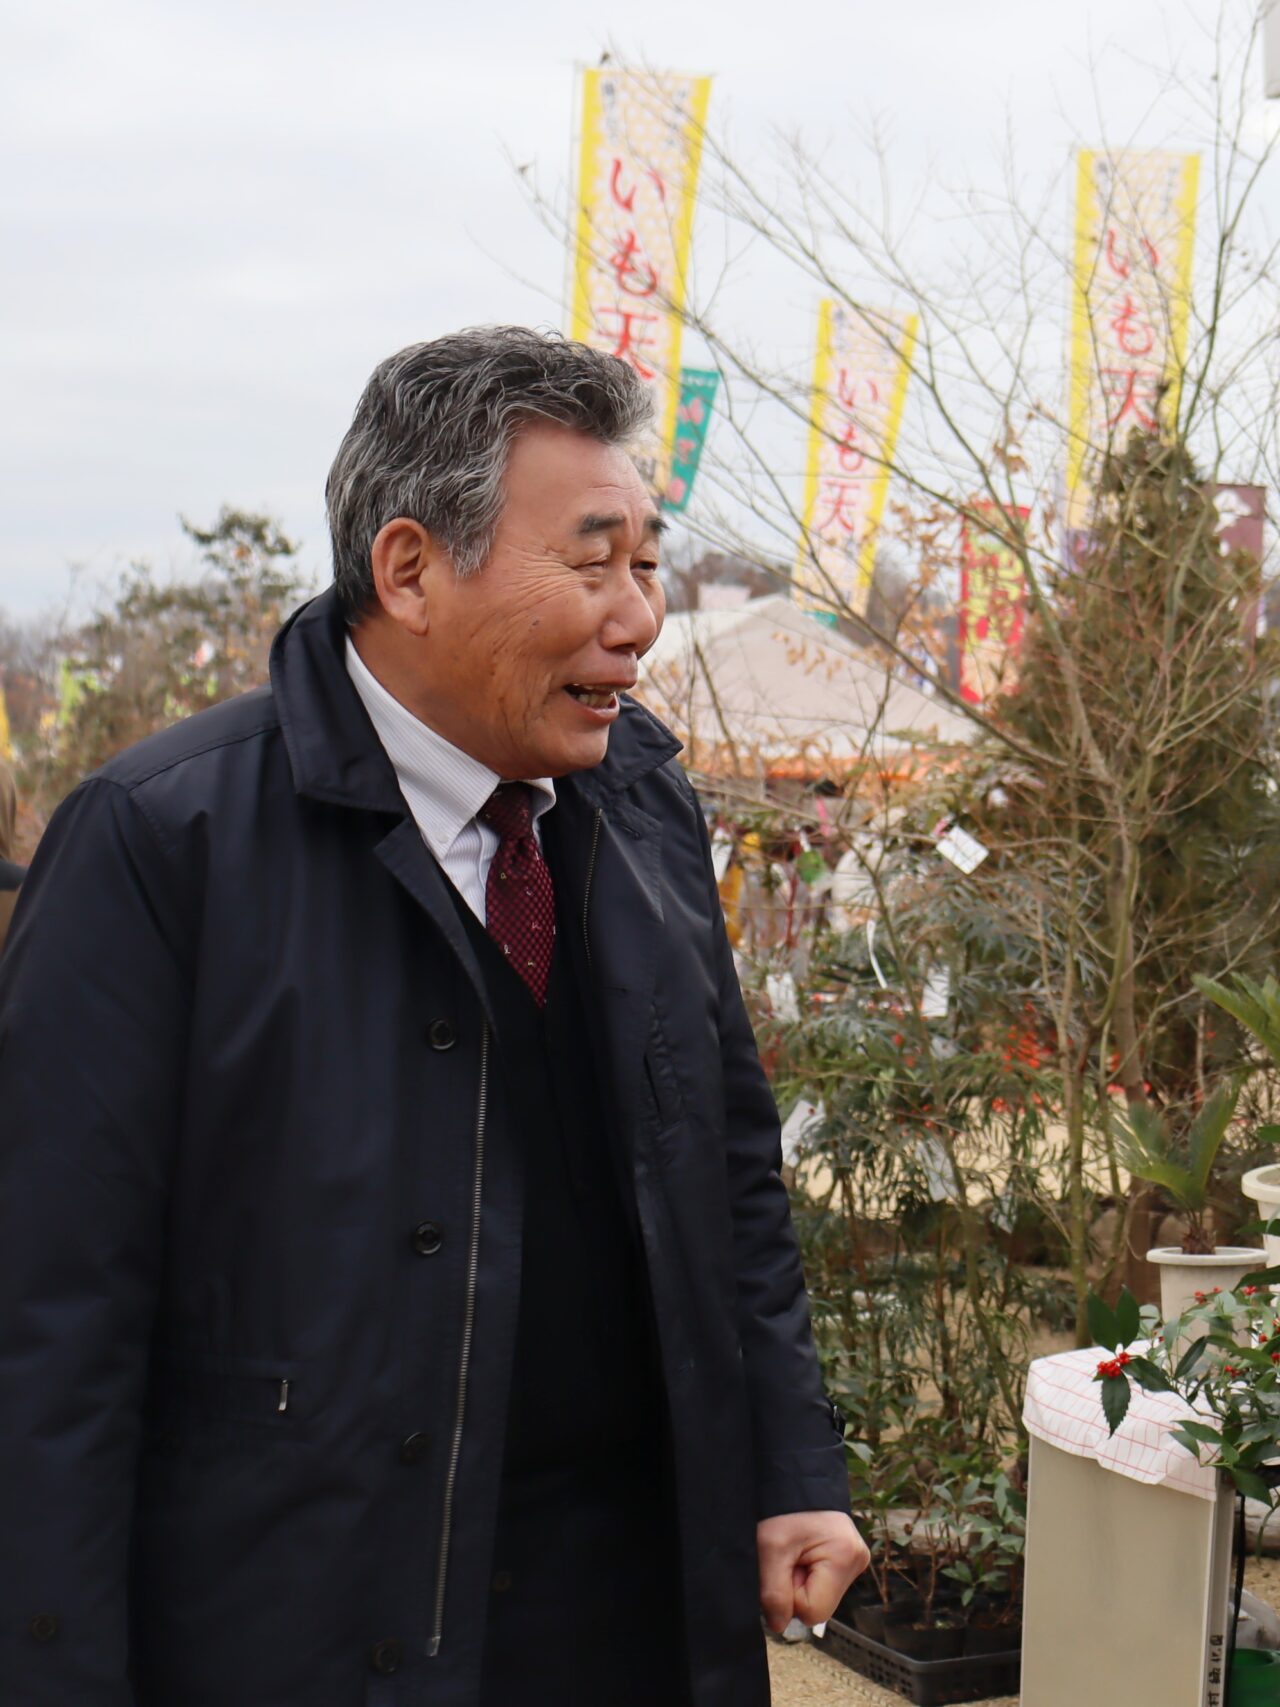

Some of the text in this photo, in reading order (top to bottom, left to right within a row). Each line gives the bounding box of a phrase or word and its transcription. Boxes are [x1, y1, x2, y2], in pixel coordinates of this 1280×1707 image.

[597, 158, 666, 380] いも天
[1099, 228, 1160, 430] いも天
[819, 368, 879, 533] いも天
